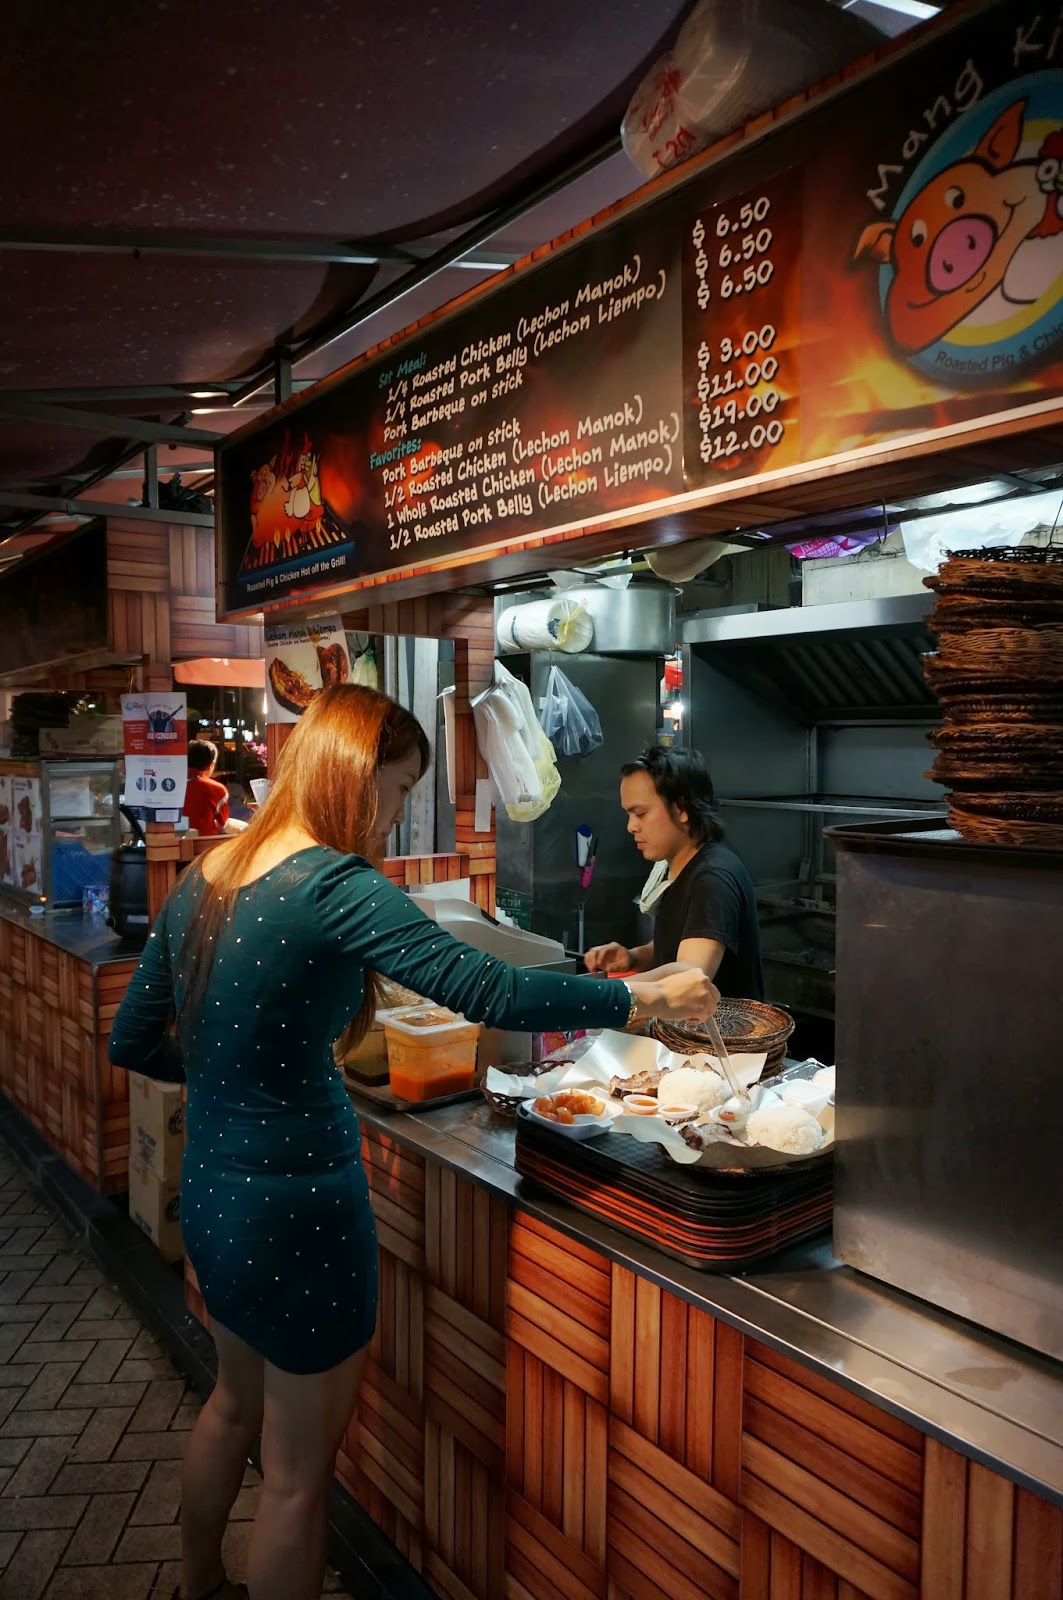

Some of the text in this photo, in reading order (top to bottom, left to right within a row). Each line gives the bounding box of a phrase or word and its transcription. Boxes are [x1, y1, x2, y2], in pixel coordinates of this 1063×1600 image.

[866, 58, 984, 211] Mang
[692, 196, 771, 249] $ 6.50
[695, 227, 773, 279] $ 6.50
[697, 259, 774, 310] $ 6.50
[384, 269, 667, 424] 1/4 Roasted Pork Belly (Lechon Liempo)
[386, 254, 641, 404] 1/4 Roasted Chicken (Lechon Manok)
[697, 324, 776, 371] $ 3.00
[378, 370, 393, 389] Set
[697, 356, 779, 402] $11.00
[935, 350, 988, 371] Roasted
[383, 370, 523, 443] Pork Barbeque on stick
[699, 389, 781, 433] $19.00
[369, 438, 422, 470] Favorites:
[382, 418, 521, 486] Pork Barbeque on stick
[384, 394, 643, 509] 1/2 Roasted Chicken (Lechon Manok)
[700, 419, 784, 463] $12.00
[387, 412, 680, 529] 1 Whole Roasted Chicken (Lechon Manok)
[389, 444, 673, 551] 1/2 Roasted Pork Belly (Lechon Liempo)
[246, 555, 346, 592] Roasted Pig & Chicken Hot off the Grill!
